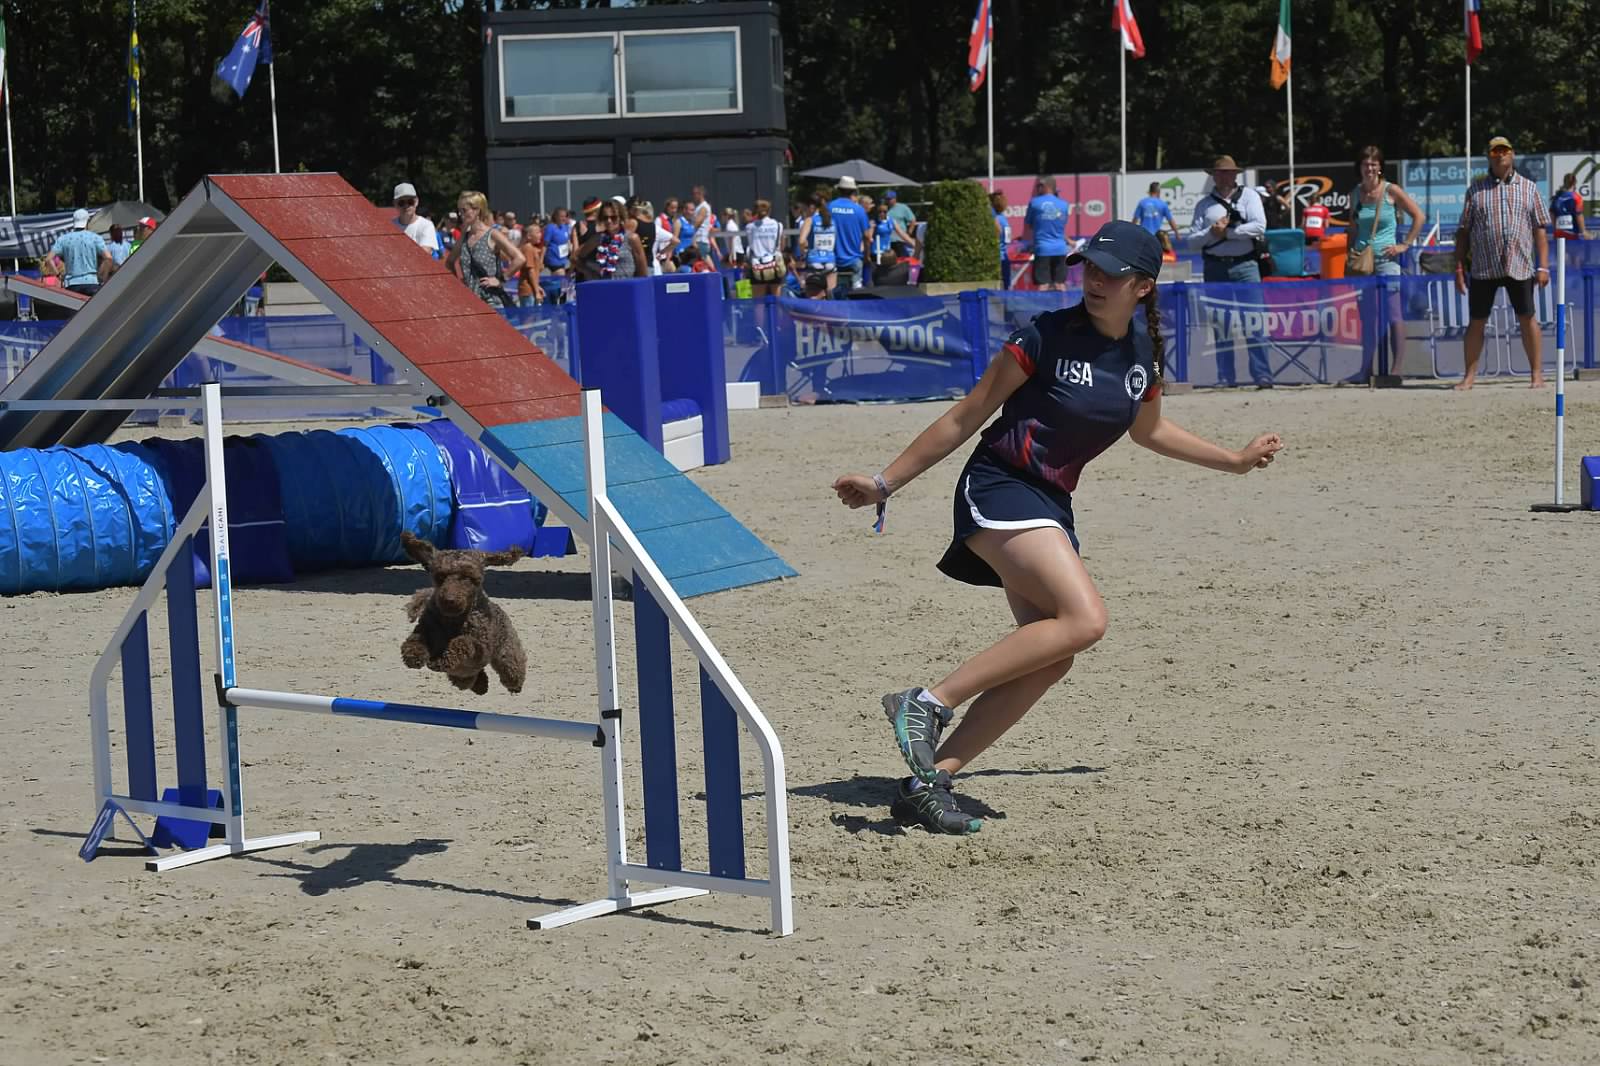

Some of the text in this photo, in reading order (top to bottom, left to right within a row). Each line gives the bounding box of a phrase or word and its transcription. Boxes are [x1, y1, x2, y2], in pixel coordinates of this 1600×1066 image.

[832, 207, 855, 215] ITALIA
[793, 320, 945, 359] HAPPY DOG
[1204, 301, 1359, 345] HAPPY DOG
[1055, 358, 1094, 387] USA
